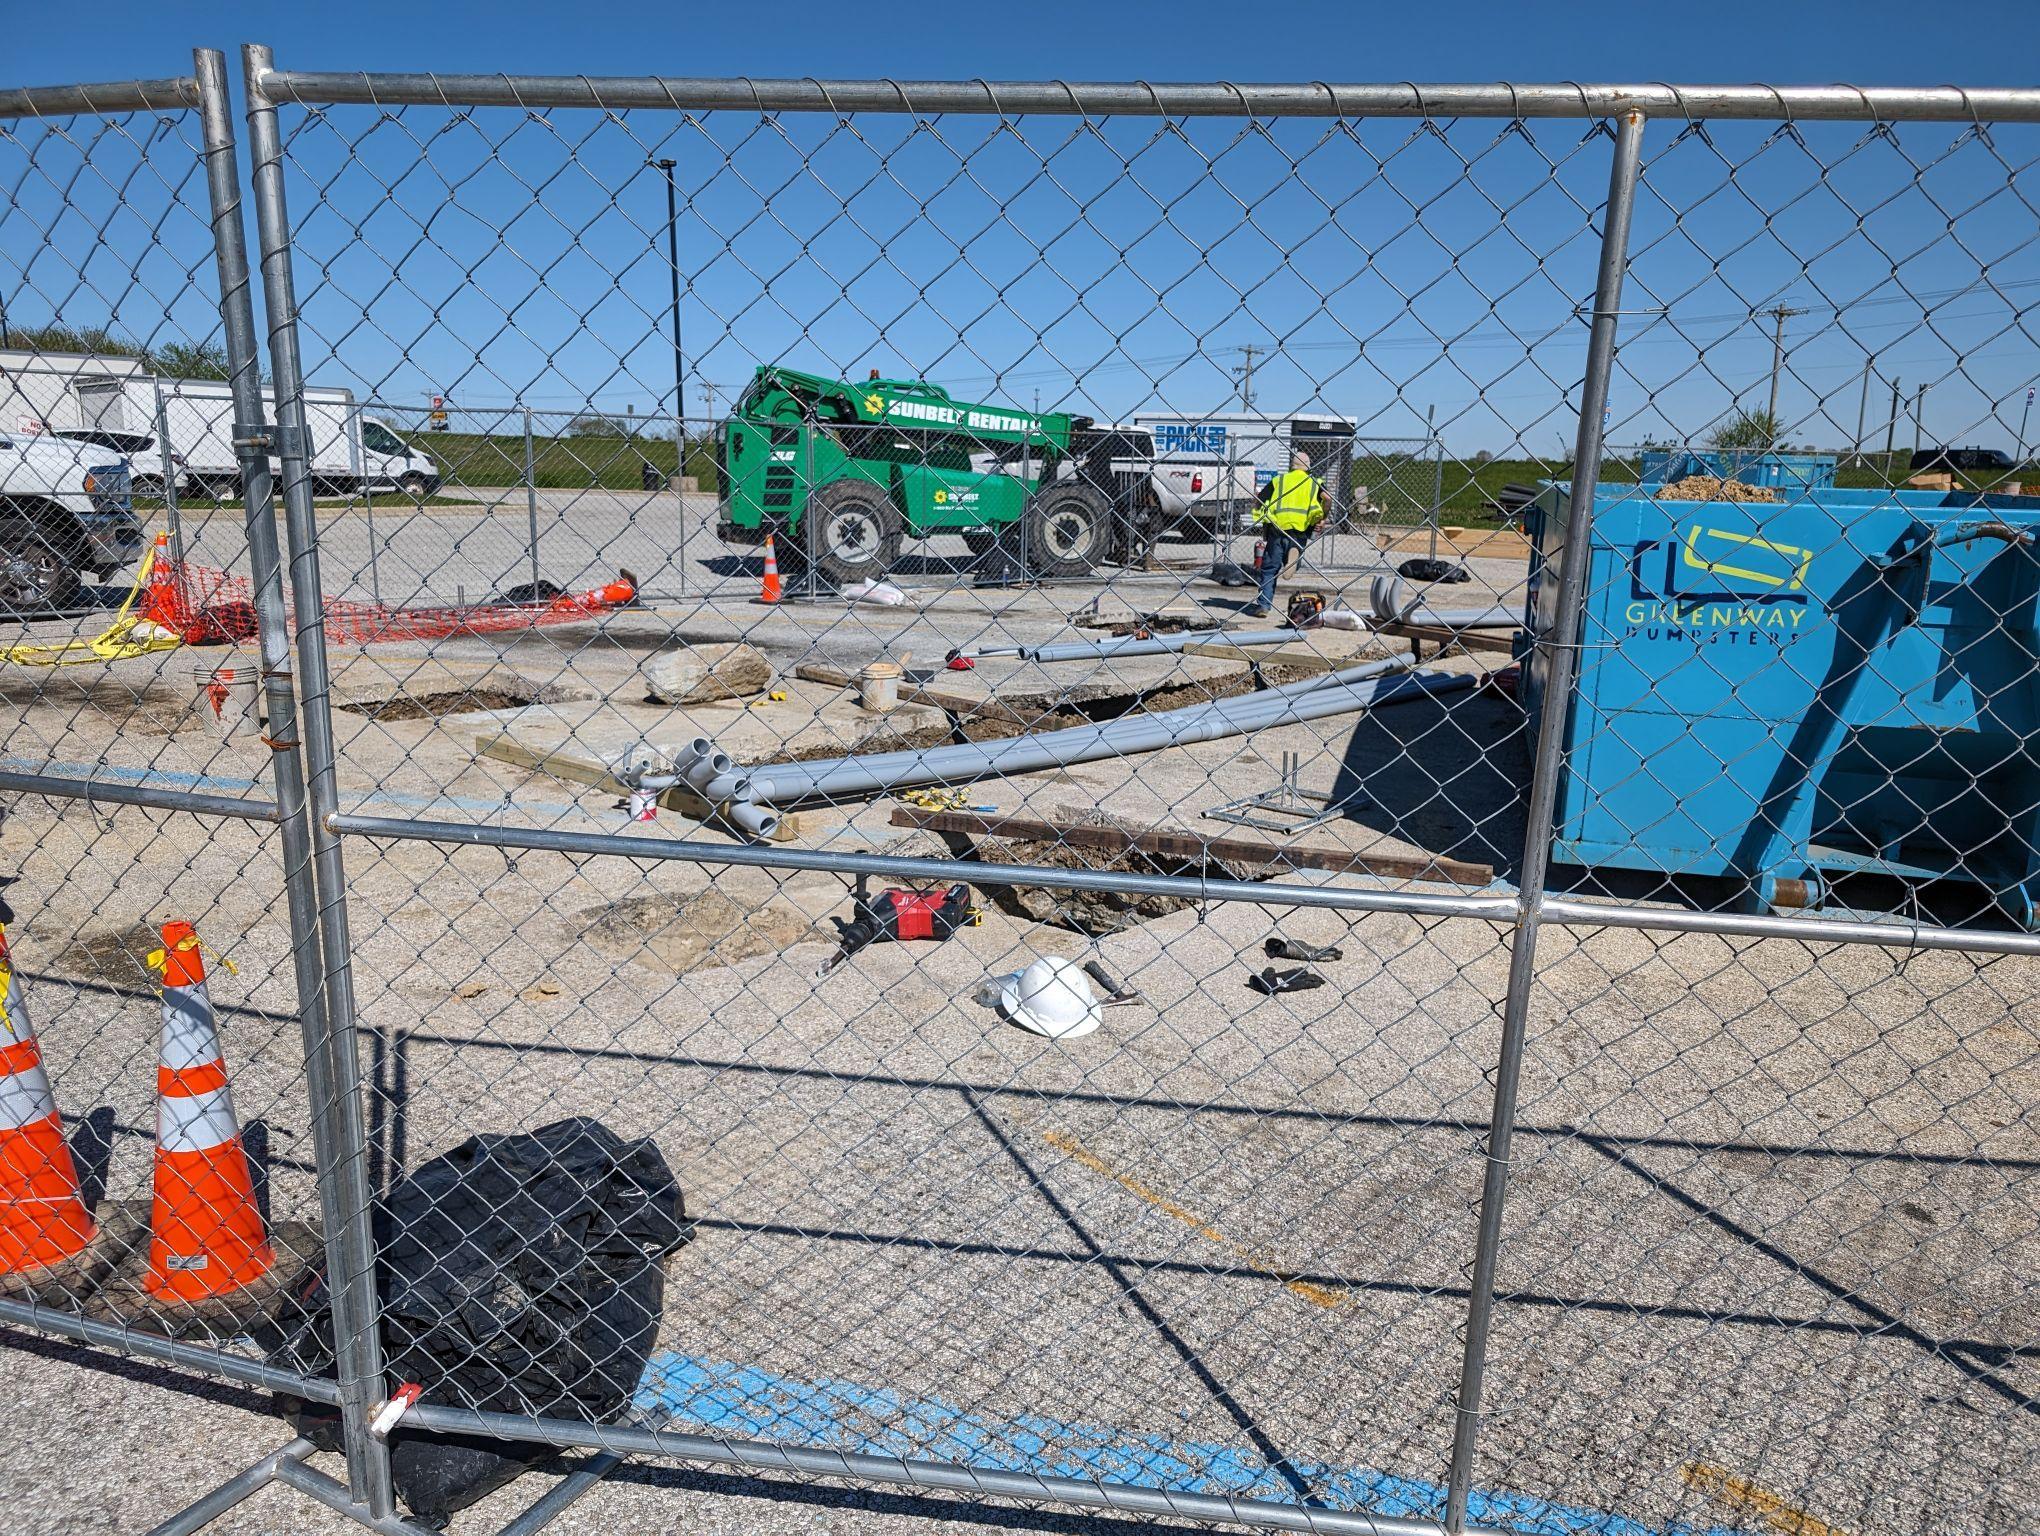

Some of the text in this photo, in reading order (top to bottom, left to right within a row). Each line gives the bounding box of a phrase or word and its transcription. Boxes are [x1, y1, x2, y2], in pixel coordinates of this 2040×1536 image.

[888, 399, 1042, 436] SUNBELT RENTALS
[1165, 425, 1207, 452] PACK
[1169, 471, 1190, 479] FX4
[1625, 626, 1801, 645] DUMPSTERS
